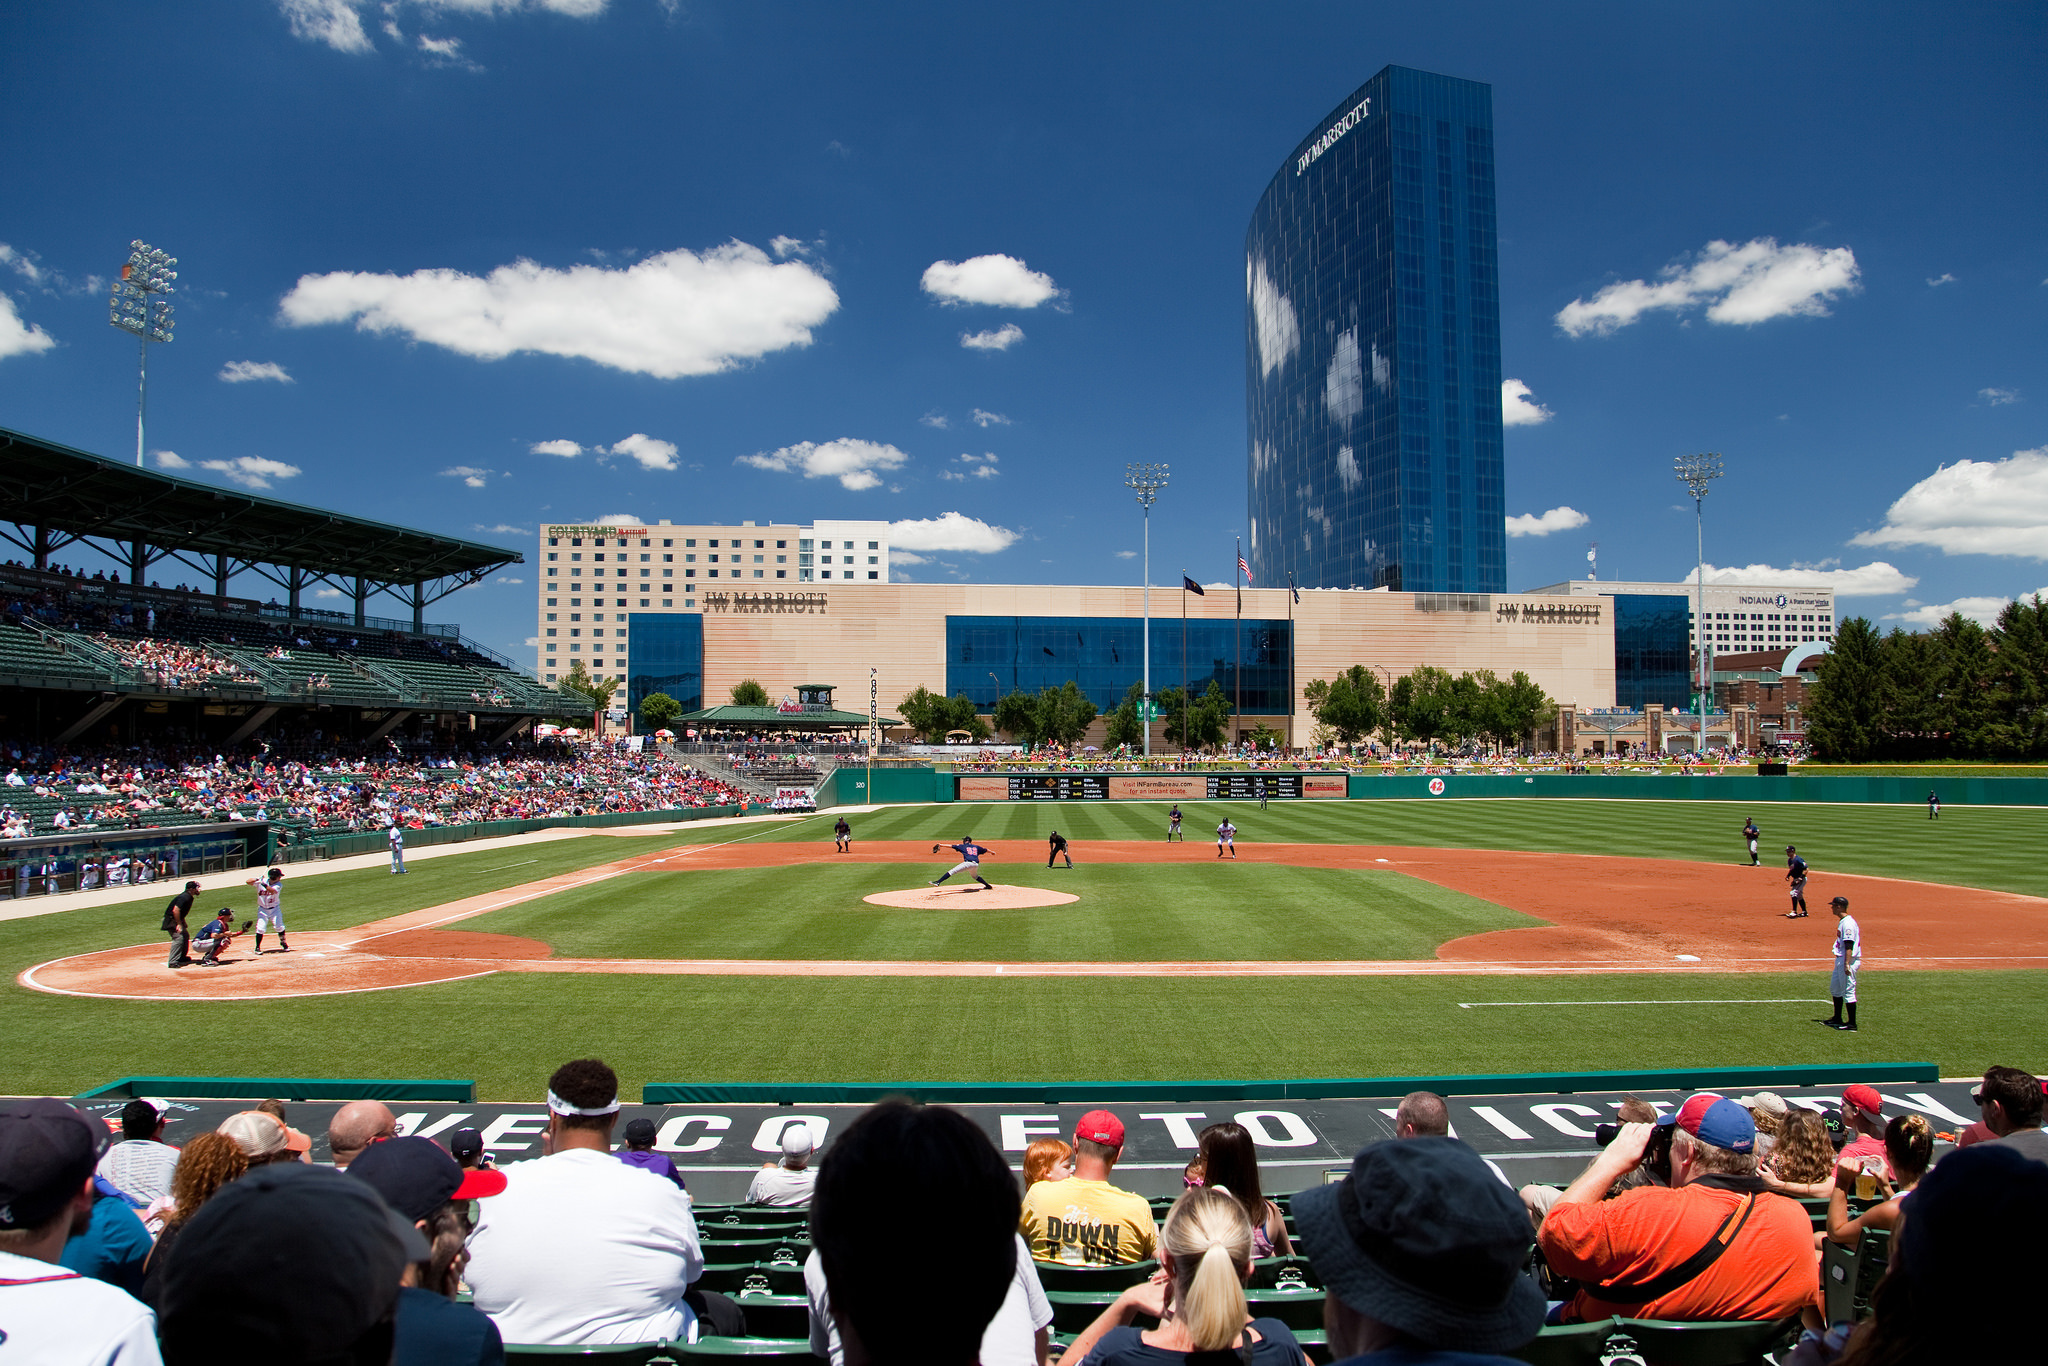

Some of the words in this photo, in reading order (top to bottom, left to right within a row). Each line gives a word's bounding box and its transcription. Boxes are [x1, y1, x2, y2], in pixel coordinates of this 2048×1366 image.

[1297, 148, 1311, 176] JW
[1311, 97, 1371, 162] MARRIOTT
[548, 526, 617, 536] COURTYARD
[617, 528, 648, 536] Marriott
[703, 592, 729, 604] JW
[733, 592, 827, 605] MARRIOTT
[1497, 603, 1519, 615] JW
[1522, 604, 1601, 616] MARRIOTT
[780, 700, 803, 712] Coors
[803, 705, 825, 713] LIGHT
[1430, 782, 1443, 791] 42
[1139, 1110, 1319, 1149] TO
[1063, 1205, 1089, 1226] It's
[1091, 1216, 1102, 1228] a
[1047, 1216, 1119, 1249] DOWN
